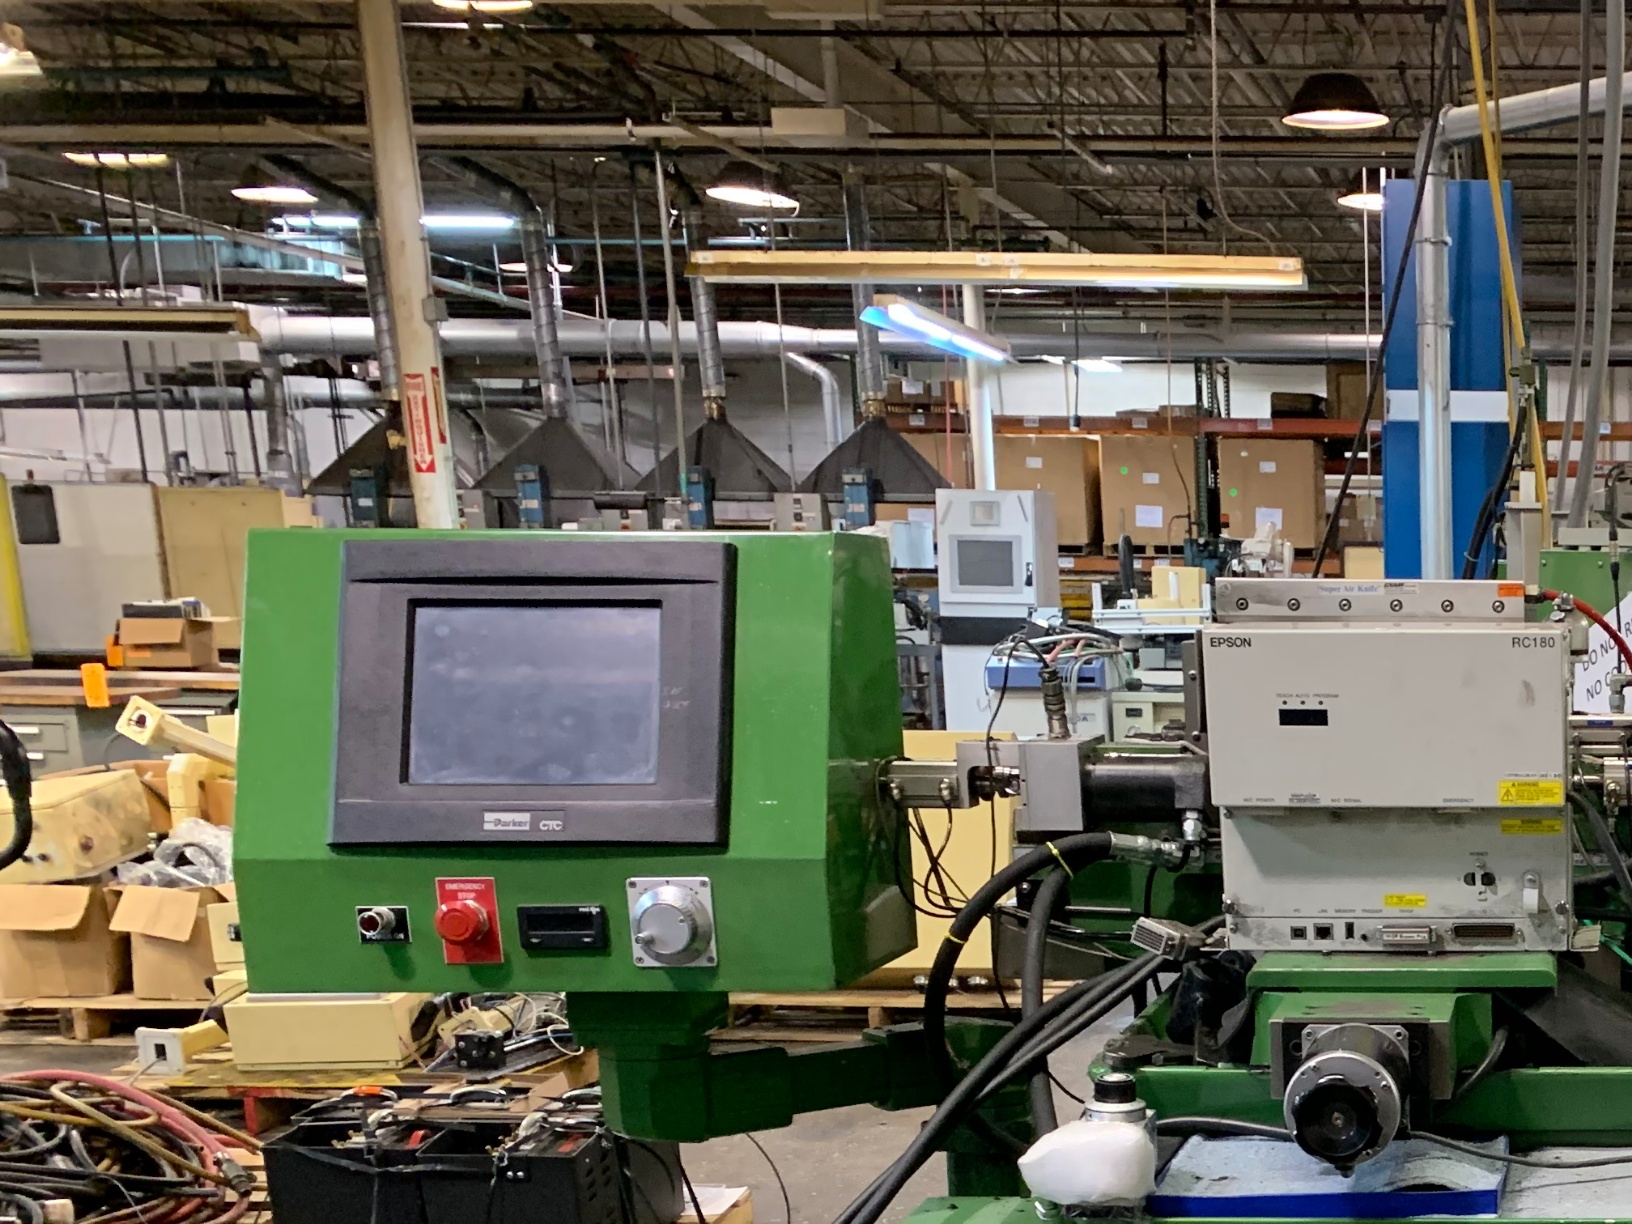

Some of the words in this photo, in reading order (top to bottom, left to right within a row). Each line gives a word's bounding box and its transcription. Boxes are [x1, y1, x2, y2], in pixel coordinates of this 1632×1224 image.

[1209, 637, 1252, 648] EPSON
[1512, 637, 1555, 648] RC180
[1586, 680, 1602, 702] NO
[494, 818, 528, 827] Parker
[539, 820, 563, 830] CTC
[445, 883, 485, 891] EMERGENCY
[457, 891, 476, 899] STOP
